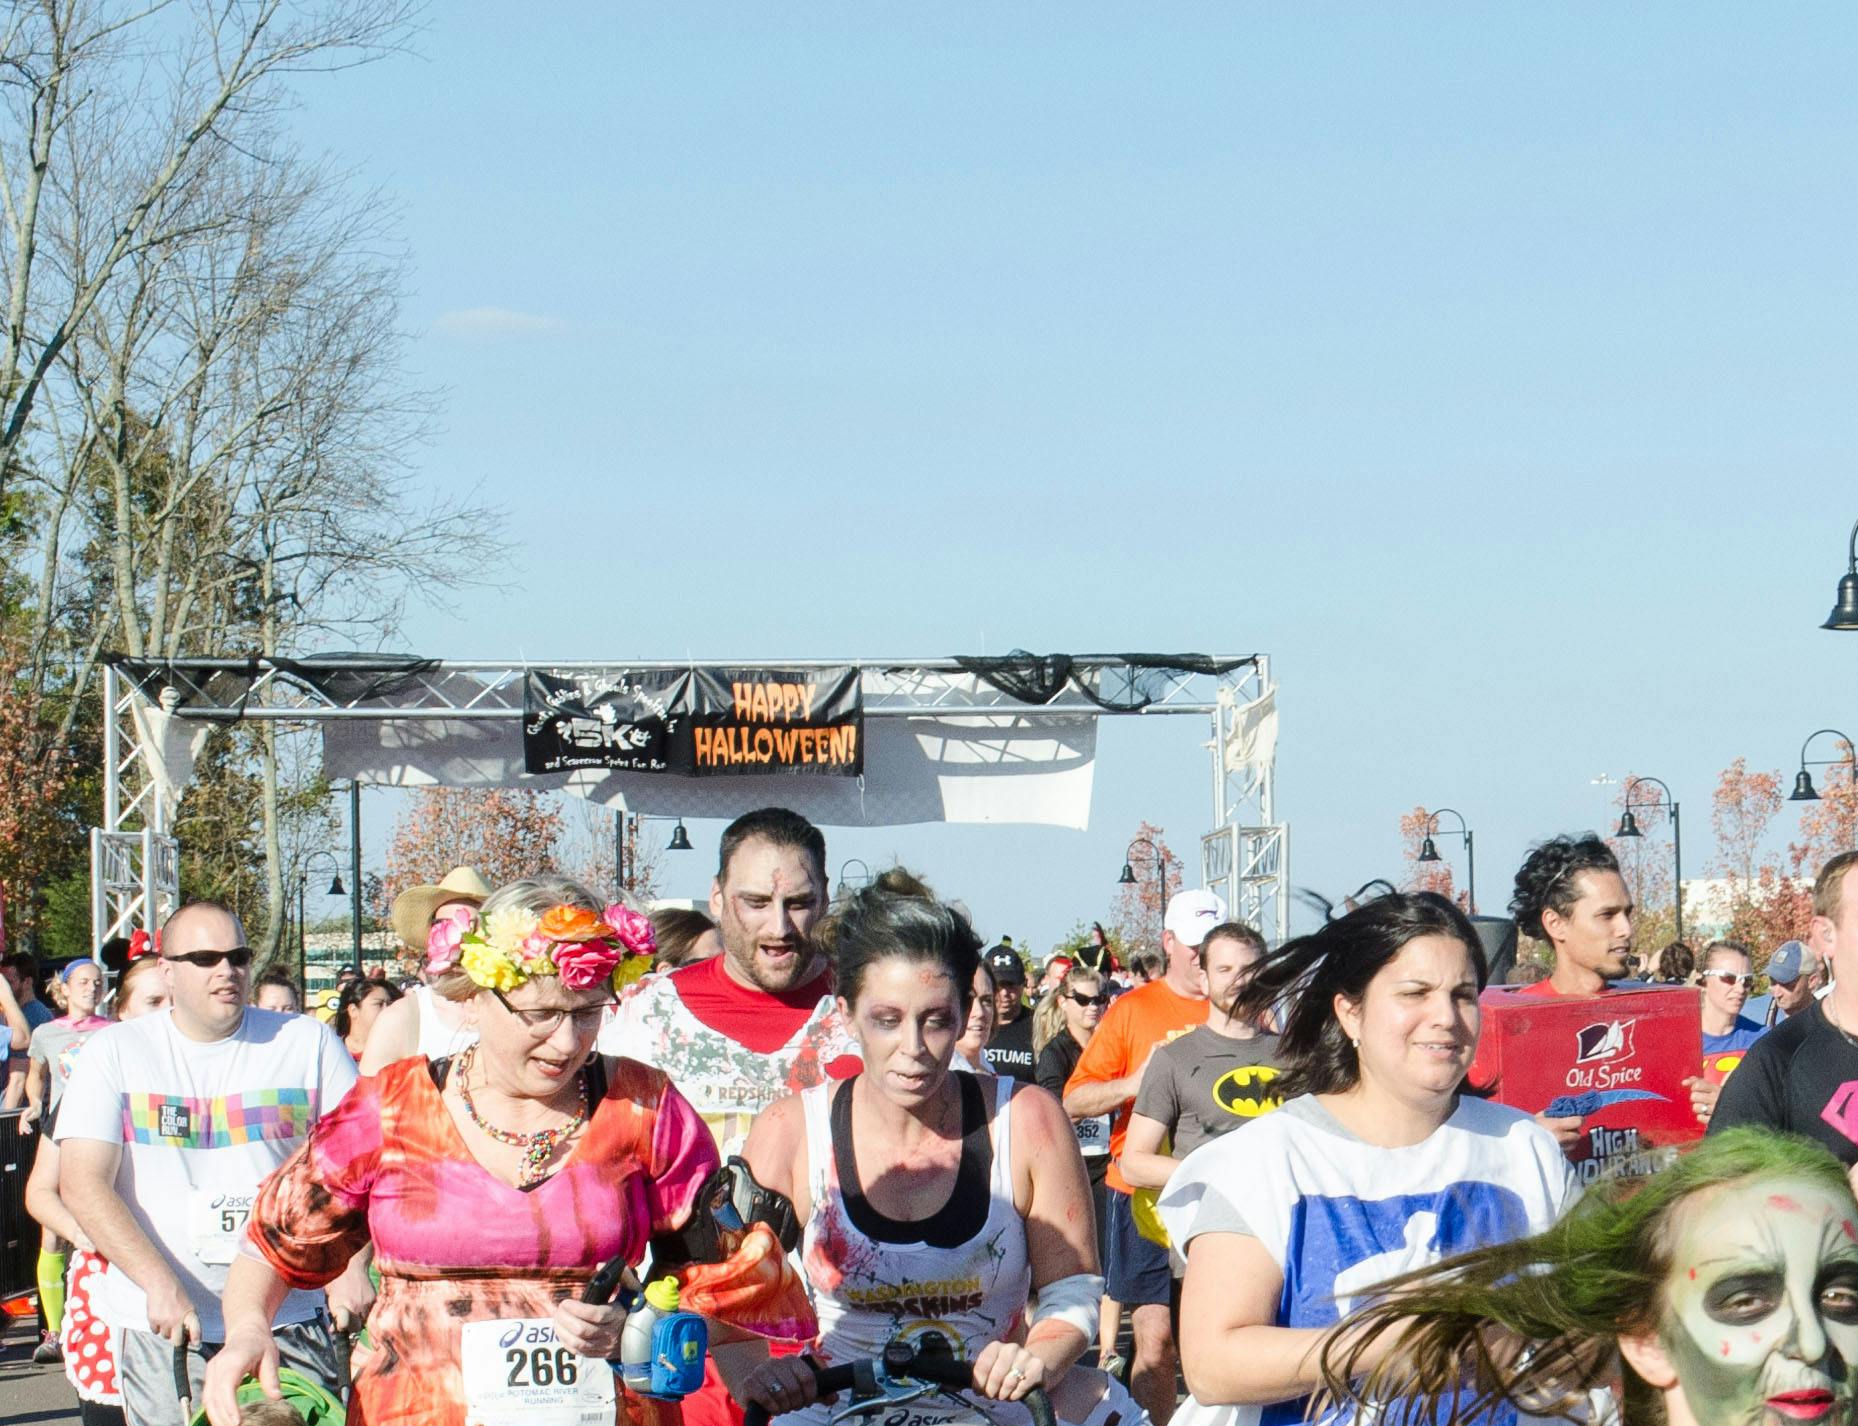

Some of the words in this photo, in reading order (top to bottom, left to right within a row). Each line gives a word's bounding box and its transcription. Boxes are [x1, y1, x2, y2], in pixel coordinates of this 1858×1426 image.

[733, 682, 817, 723] HAPPY
[571, 717, 634, 751] 5K
[694, 725, 857, 767] HALLOWEEN!
[984, 1048, 1032, 1065] STUME
[1565, 1067, 1594, 1088] Old
[1595, 1065, 1643, 1089] Spice
[161, 1105, 177, 1117] THE
[161, 1115, 188, 1128] COLOR
[1077, 1125, 1099, 1139] 352
[1589, 1126, 1638, 1158] HIGH
[226, 1196, 253, 1207] asic
[222, 1210, 250, 1232] 57
[526, 1326, 560, 1344] asi
[506, 1347, 578, 1387] 266
